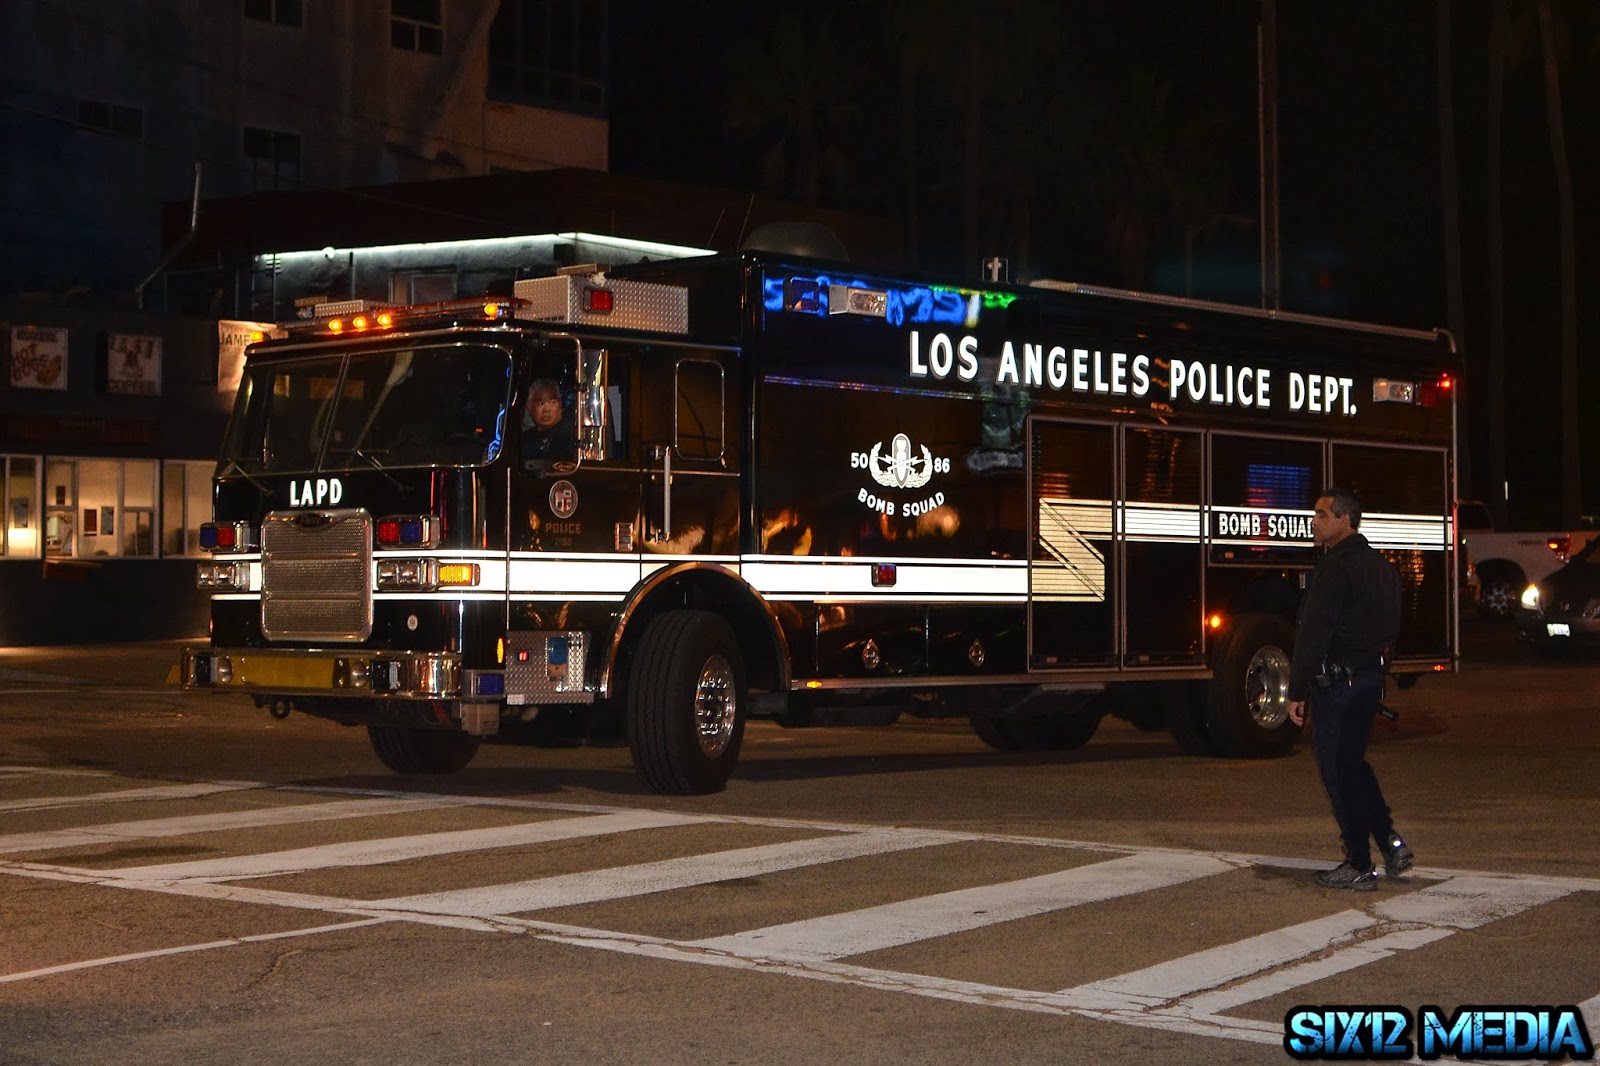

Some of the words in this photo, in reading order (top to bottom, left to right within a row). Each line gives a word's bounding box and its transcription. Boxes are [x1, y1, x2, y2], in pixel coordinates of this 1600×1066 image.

[910, 331, 978, 381] LOS
[996, 341, 1150, 396] ANGELES
[1169, 359, 1271, 409] POLICE
[1289, 372, 1357, 417] DEPT.
[850, 452, 869, 469] 50
[933, 457, 951, 474] 86
[289, 478, 342, 507] LAPD
[857, 487, 895, 516] BOMB
[902, 491, 945, 517] SQUAD
[545, 522, 582, 535] POLICE
[1219, 513, 1261, 536] BOMB
